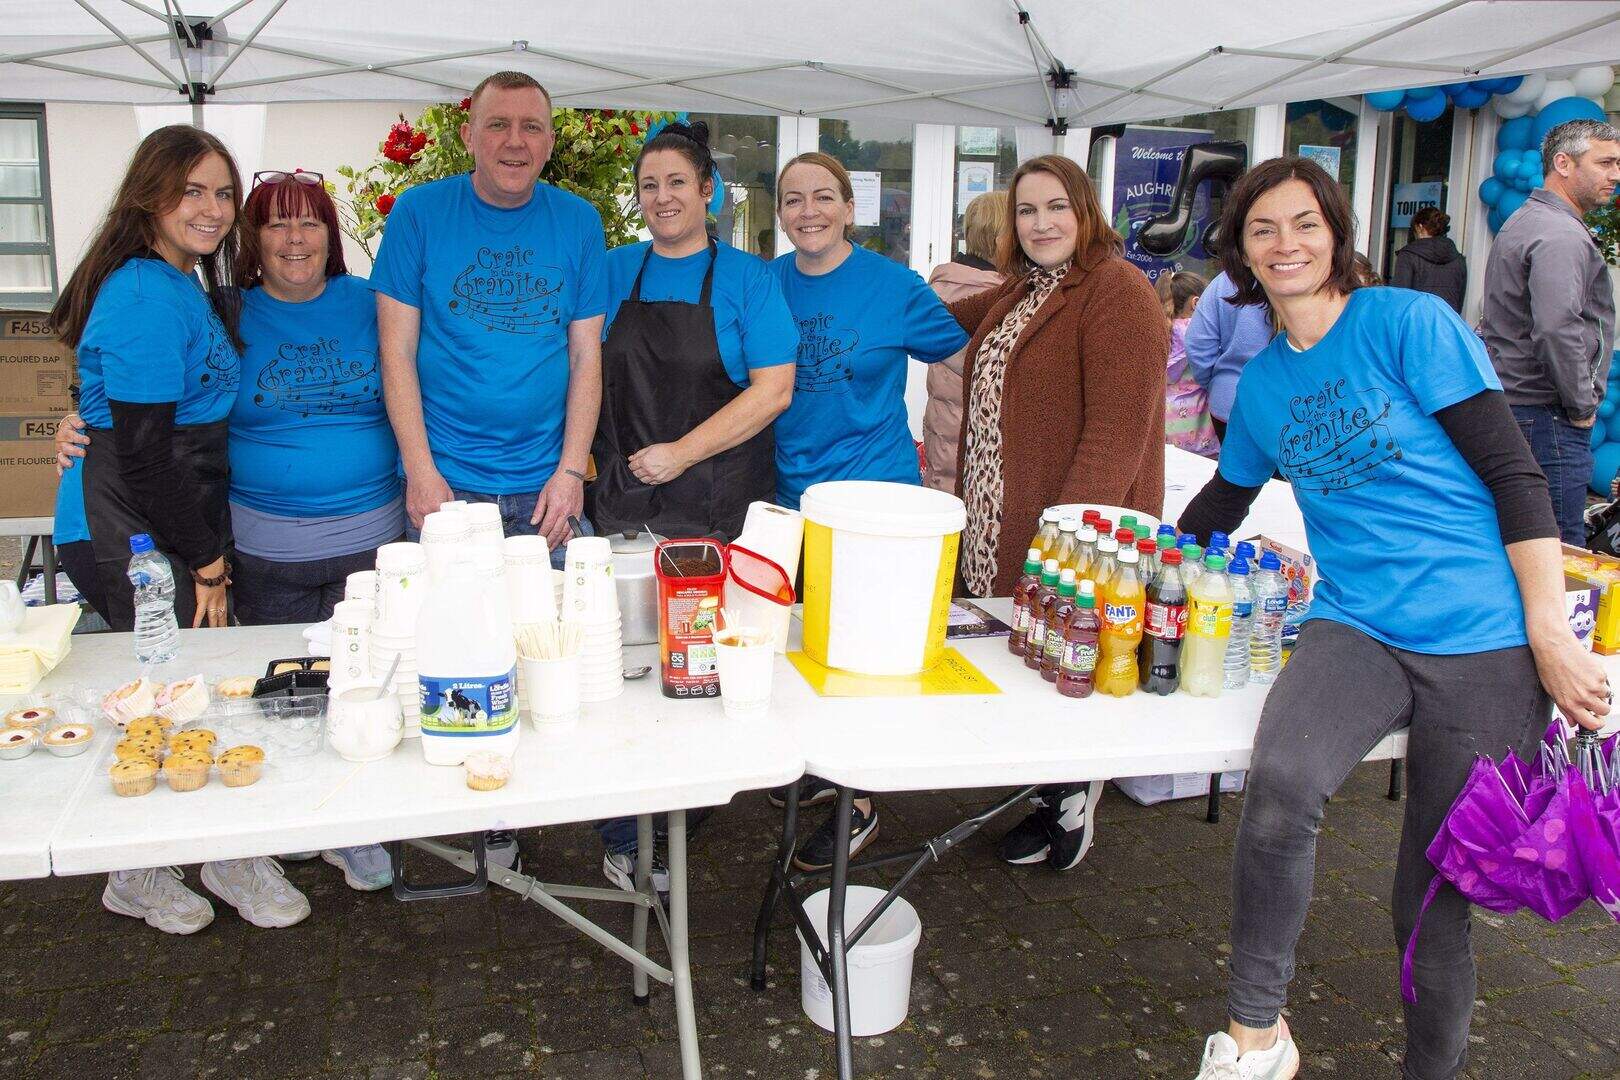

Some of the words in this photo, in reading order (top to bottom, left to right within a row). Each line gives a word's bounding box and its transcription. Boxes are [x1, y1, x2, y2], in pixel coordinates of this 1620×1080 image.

[1131, 146, 1174, 161] Welcome
[1126, 182, 1176, 201] AUGHRI
[477, 245, 534, 270] Craic
[1160, 262, 1183, 278] CUB
[279, 336, 342, 361] Craic
[0, 355, 41, 364] FLOURED
[42, 355, 60, 363] BAP
[1289, 378, 1347, 424] Craic
[17, 457, 58, 465] FLOURED
